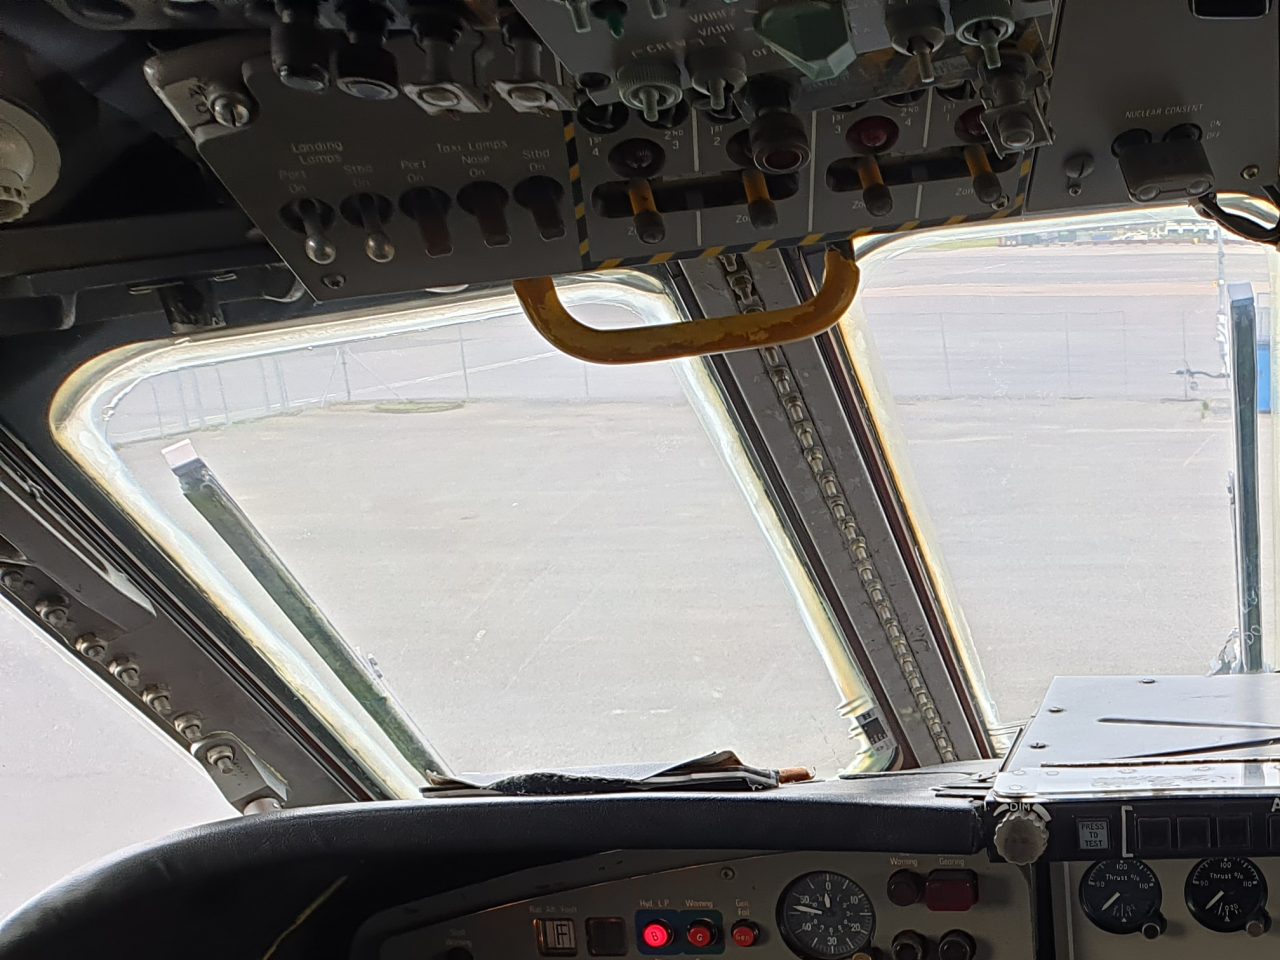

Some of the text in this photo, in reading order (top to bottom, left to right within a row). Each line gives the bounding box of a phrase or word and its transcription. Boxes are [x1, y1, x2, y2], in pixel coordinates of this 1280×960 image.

[1124, 103, 1204, 119] NUCLEAR CONSENT
[290, 140, 344, 154] Landing
[467, 138, 510, 151] Lamps
[298, 153, 342, 166] Lamps
[461, 153, 491, 165] Nose
[522, 148, 551, 161] Stbd
[400, 159, 428, 171] Port
[1081, 822, 1106, 832] PRESS
[1089, 831, 1100, 840] TO
[1084, 839, 1104, 848] TEST
[1105, 873, 1130, 882] Thrust
[1208, 871, 1233, 881] Thrust
